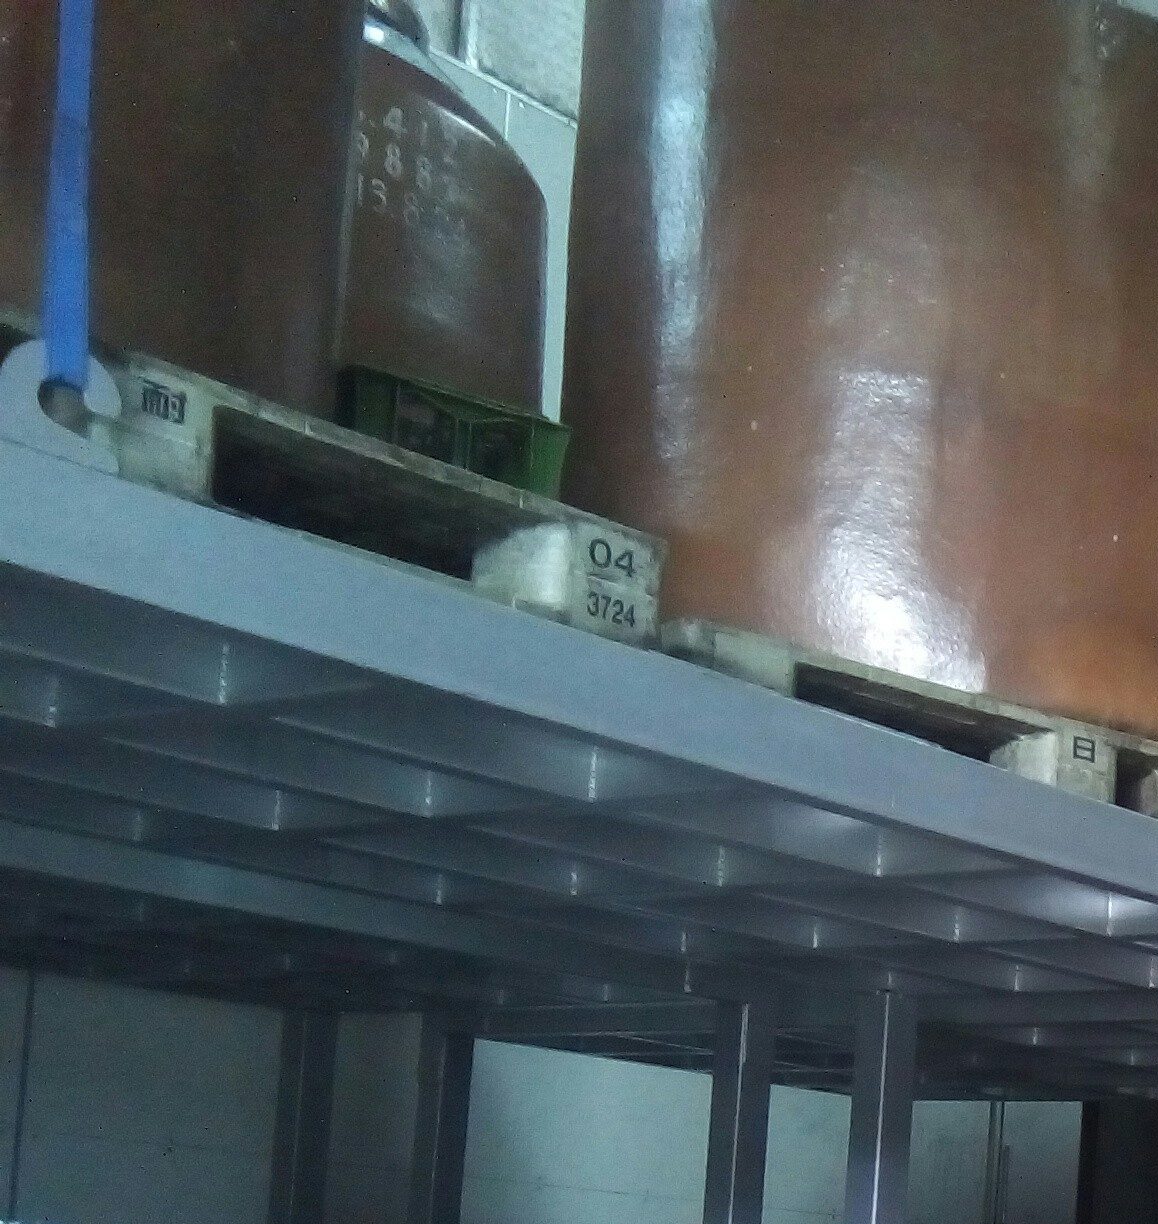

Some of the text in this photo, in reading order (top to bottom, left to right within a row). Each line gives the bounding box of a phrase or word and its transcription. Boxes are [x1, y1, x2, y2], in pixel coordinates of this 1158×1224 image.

[589, 538, 637, 578] 04
[587, 590, 636, 628] 3724
[1073, 735, 1095, 764] 日
